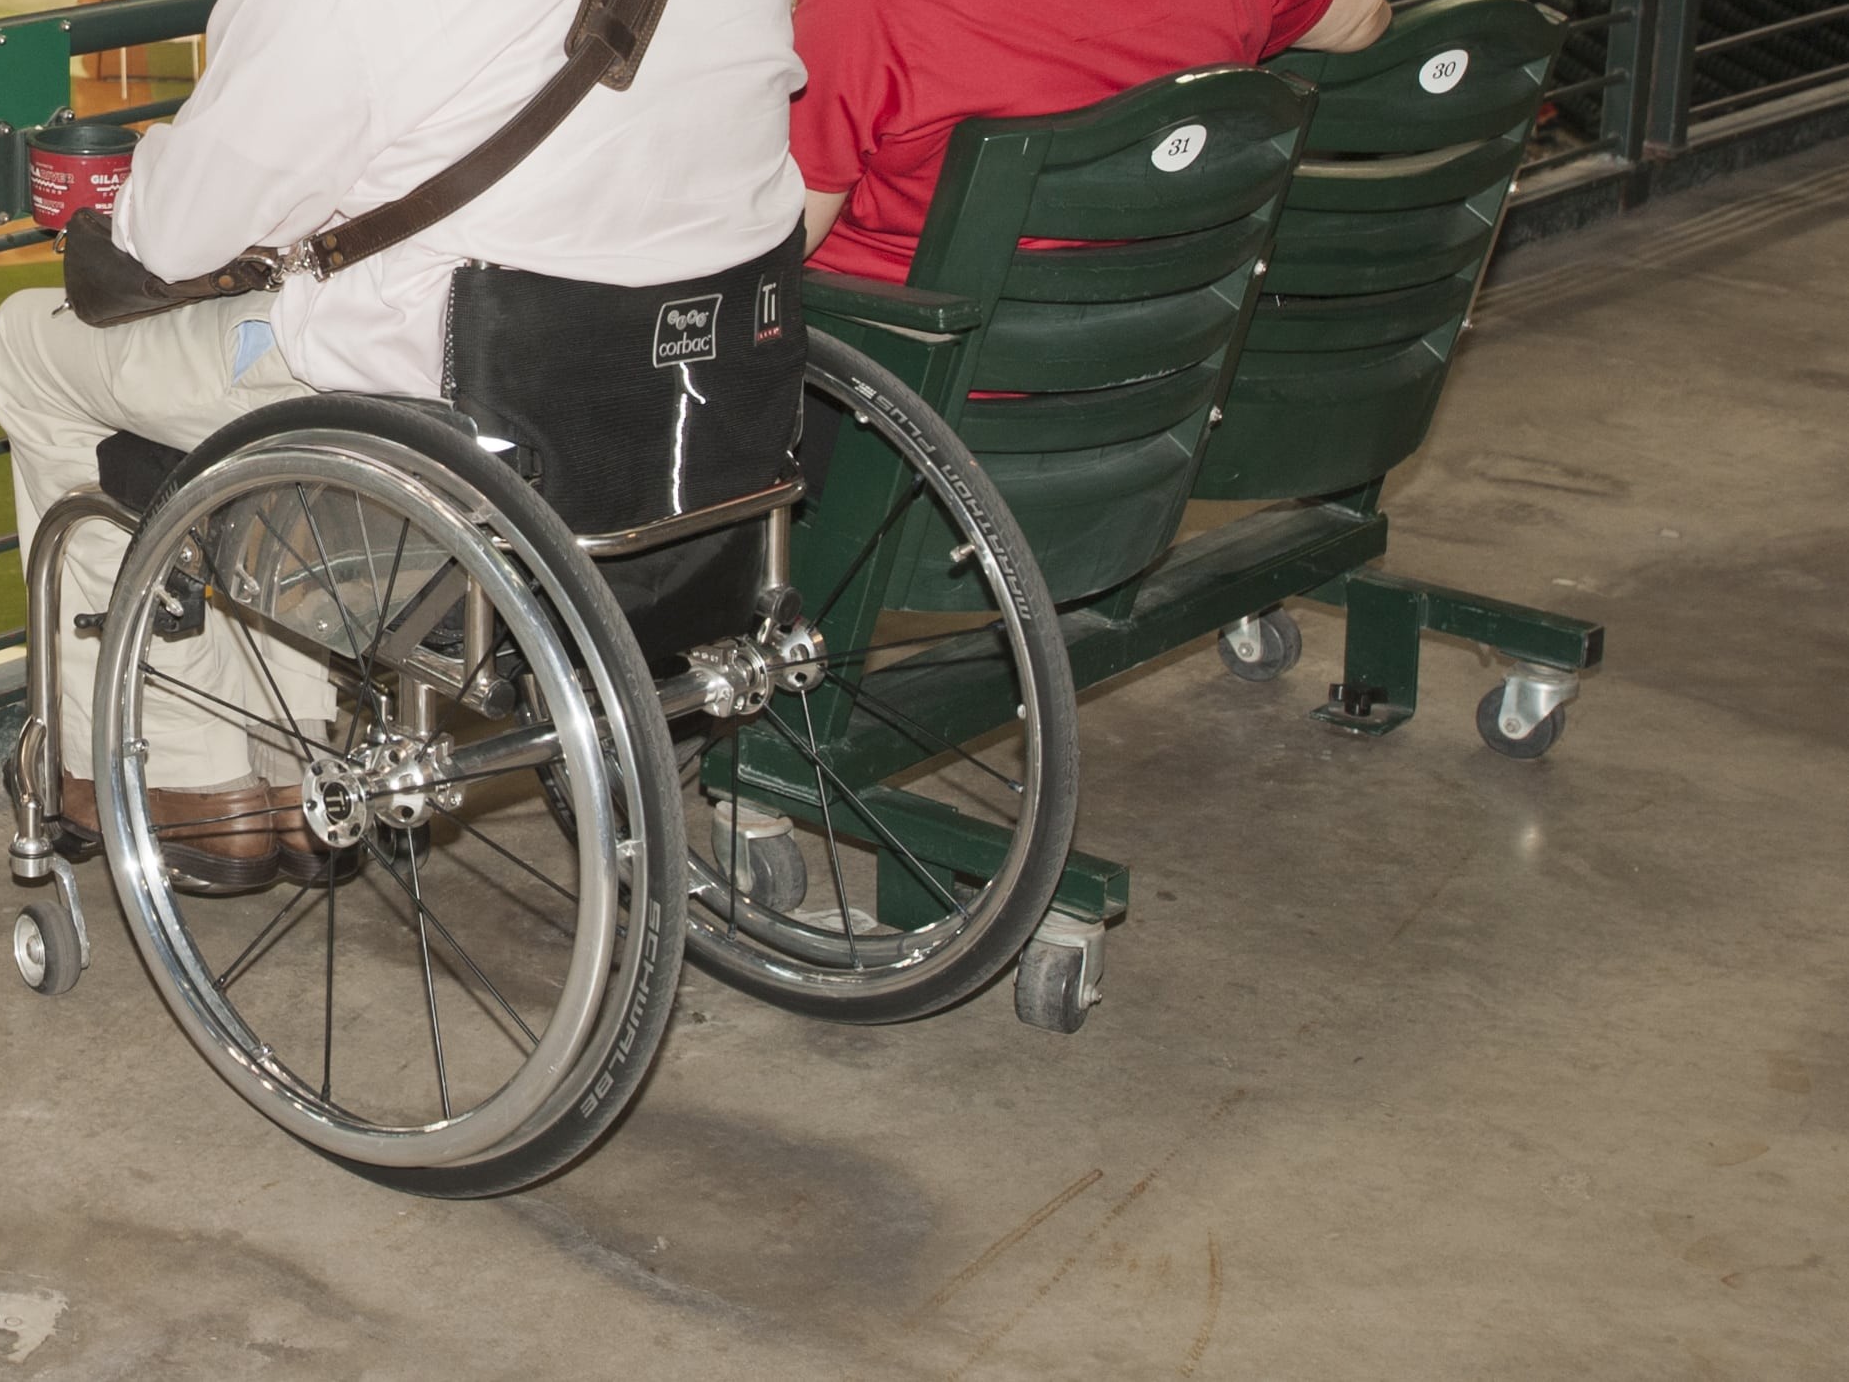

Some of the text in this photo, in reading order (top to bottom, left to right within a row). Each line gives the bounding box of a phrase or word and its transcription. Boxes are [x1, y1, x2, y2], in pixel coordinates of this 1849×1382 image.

[1432, 61, 1457, 80] 30
[1167, 137, 1191, 157] 31
[659, 331, 711, 358] corbac
[874, 394, 1032, 621] MARATHON PLUS
[580, 898, 661, 1118] SCHWALBE
